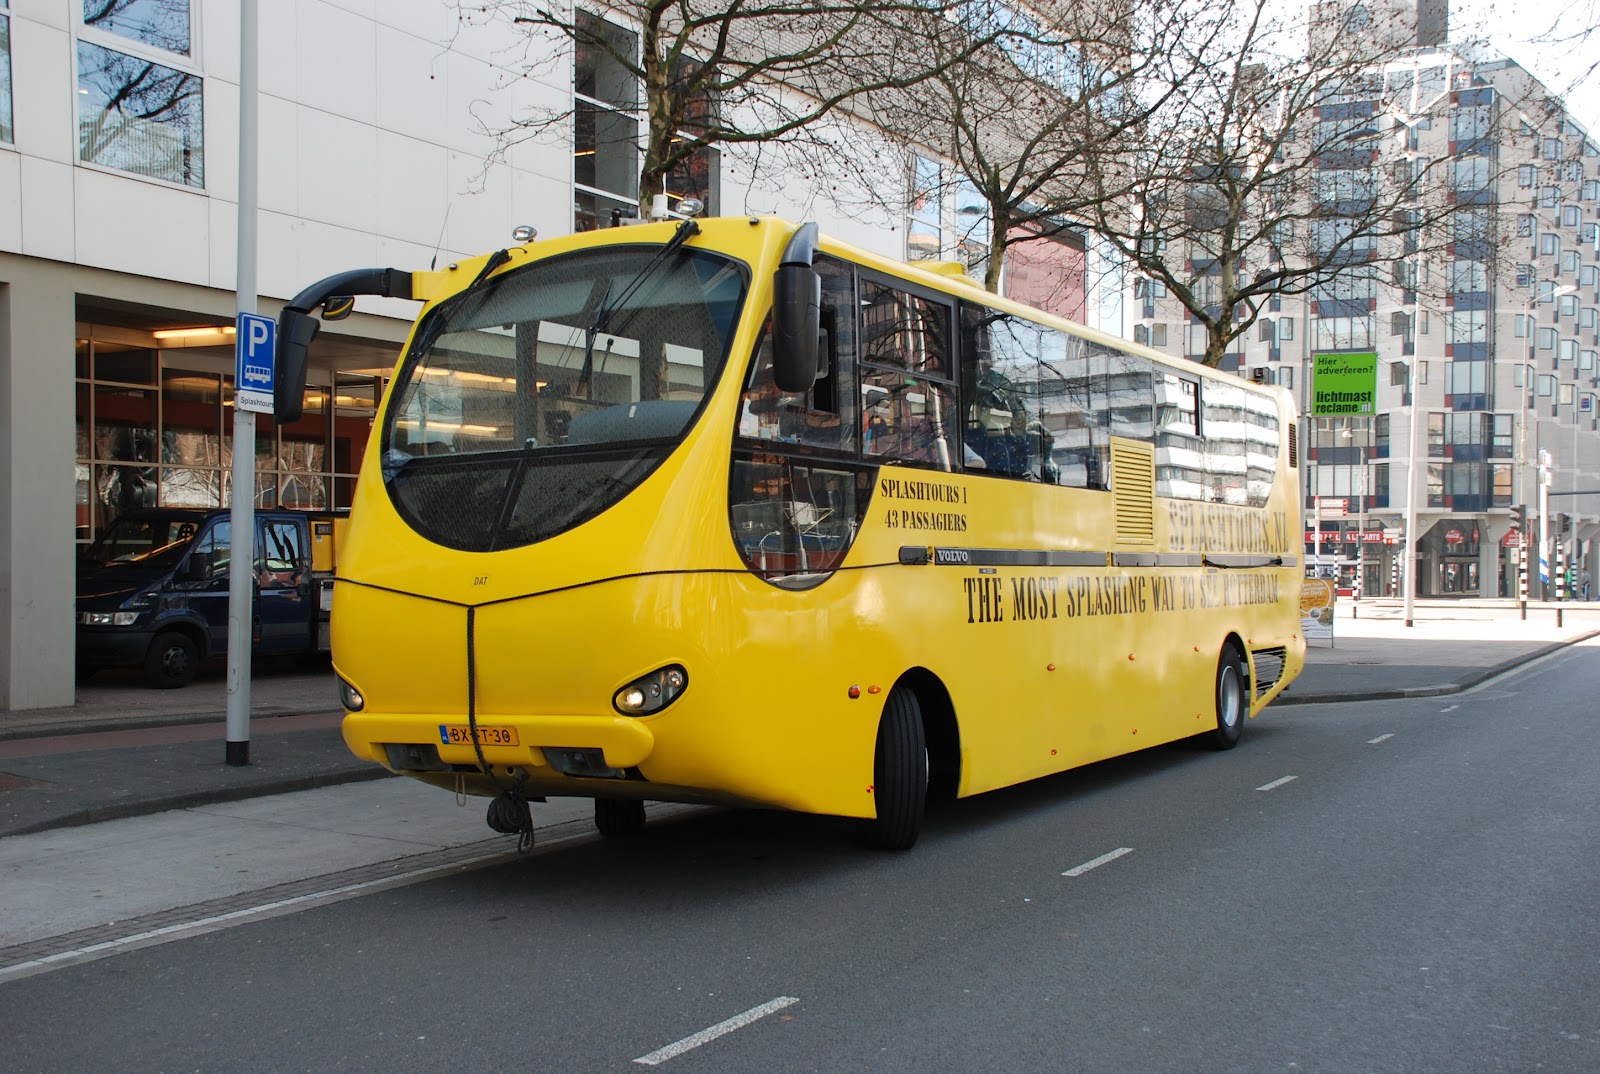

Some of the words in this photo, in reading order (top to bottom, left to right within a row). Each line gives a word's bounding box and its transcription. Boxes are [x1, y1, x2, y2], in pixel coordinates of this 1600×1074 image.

[249, 319, 268, 357] P
[1317, 357, 1337, 366] Hier
[1317, 365, 1374, 375] adverteren?
[1316, 390, 1372, 403] lichtmast
[1316, 402, 1371, 413] reclame.nl
[881, 478, 960, 504] SPLASHTOURS
[884, 509, 899, 529] 43
[901, 510, 967, 532] PASSAGIERS
[937, 550, 968, 562] VOLVO
[474, 576, 488, 586] DAT
[963, 577, 1003, 623] THE
[1011, 577, 1059, 621] MOST
[1067, 576, 1146, 618] SPLASHING
[1150, 576, 1176, 612] WAY
[1181, 576, 1195, 609] TO
[1223, 574, 1278, 606] ROTTERDAM
